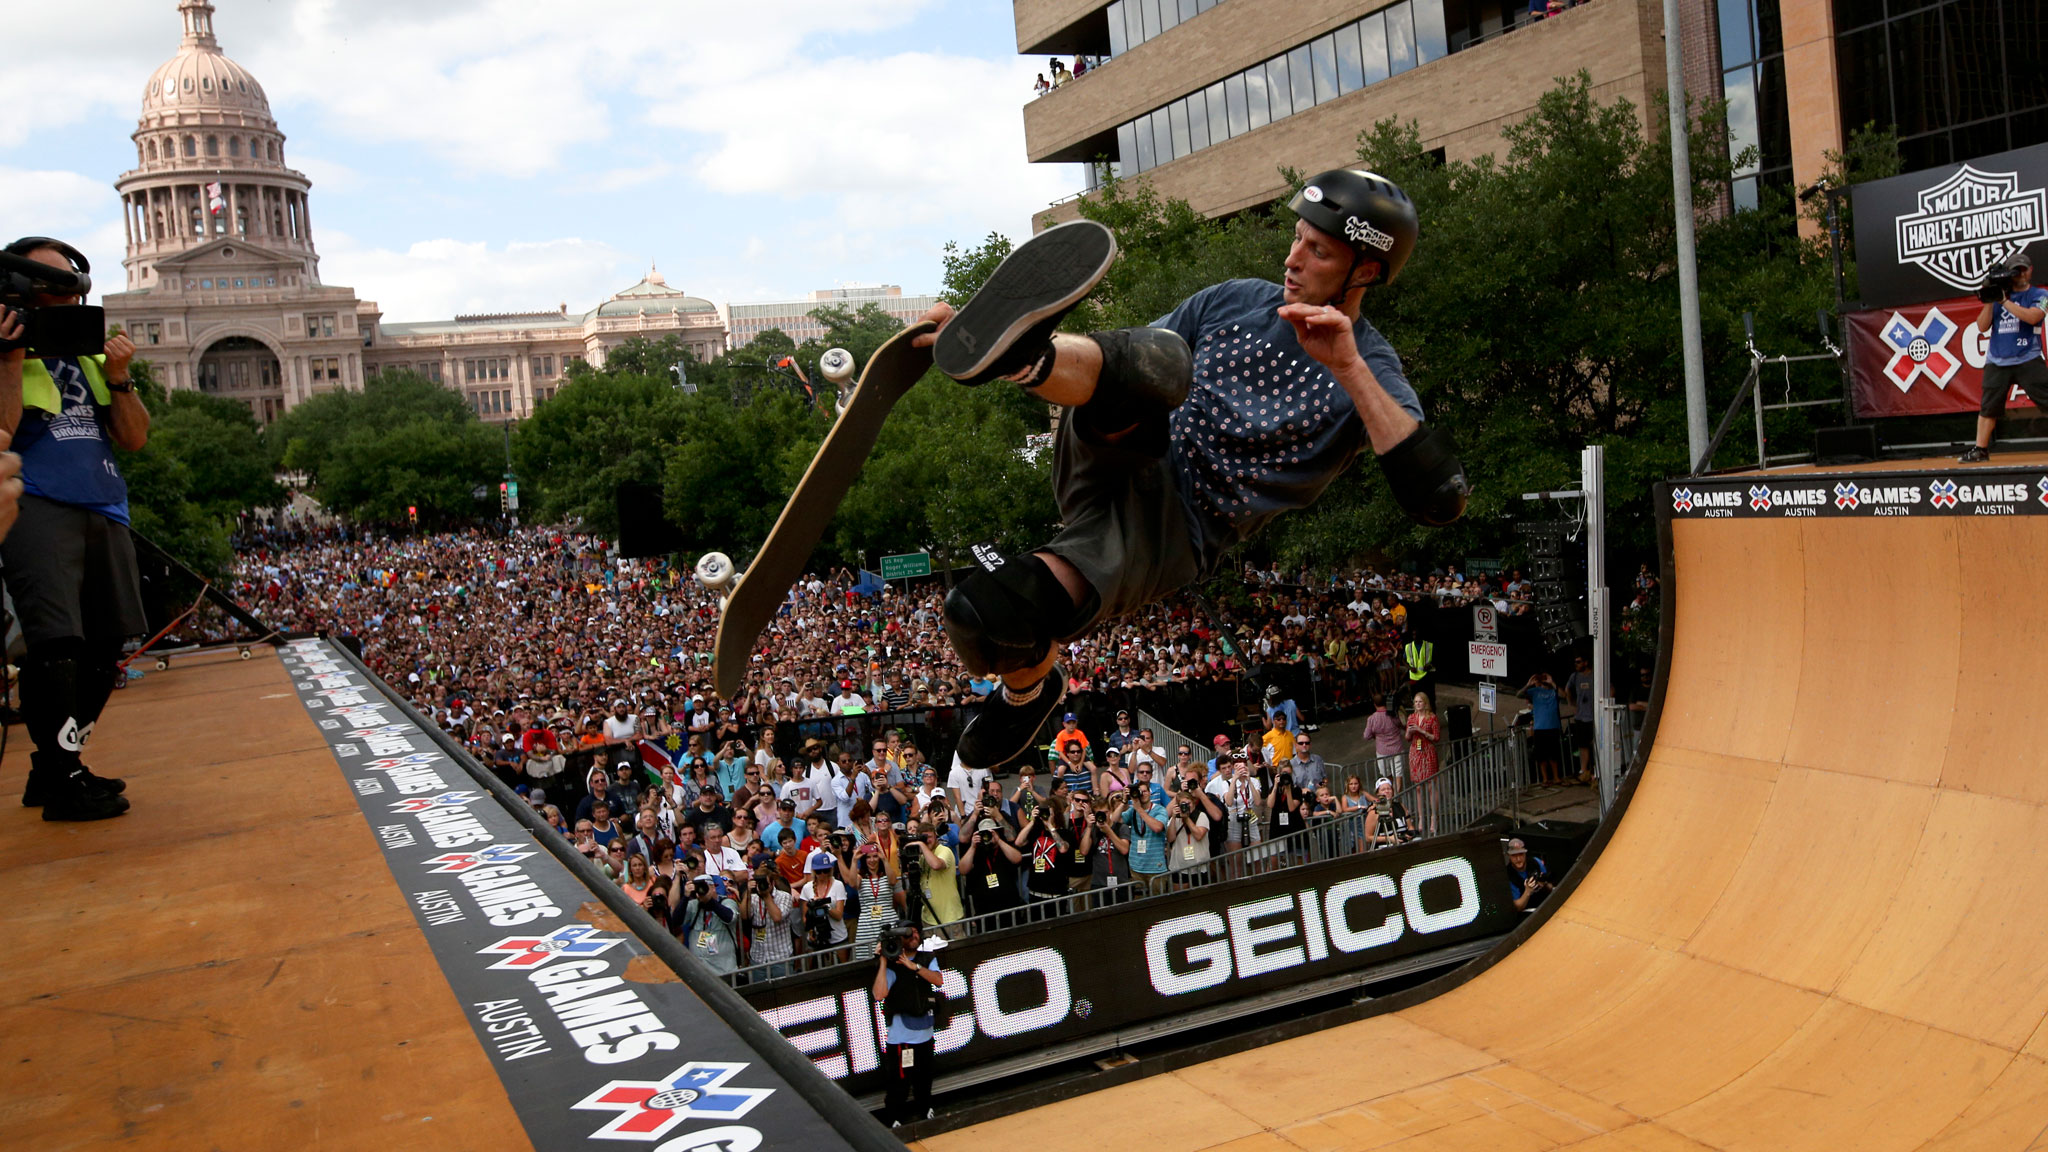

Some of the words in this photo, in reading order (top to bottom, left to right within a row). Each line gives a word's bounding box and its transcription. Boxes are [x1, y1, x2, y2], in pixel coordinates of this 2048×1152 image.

[1935, 180, 2000, 213] MOTOR
[1908, 204, 2032, 250] HARLEY-DAVIDSON
[1937, 242, 2004, 279] CYCLES
[2016, 338, 2028, 346] 28
[52, 427, 100, 438] BROADCAST
[1693, 491, 1742, 507] GAMES
[1772, 488, 1827, 506] GAMES
[1859, 487, 1921, 504] GAMES
[1958, 484, 2029, 503] GAMES
[1705, 509, 1733, 518] AUSTIN
[1784, 507, 1816, 517] AUSTIN
[1873, 506, 1909, 516] AUSTIN
[1974, 505, 2015, 515] AUSTIN
[980, 544, 1005, 565] 187
[1471, 644, 1506, 657] EMERGENCY
[1482, 659, 1495, 670] EXIT
[377, 824, 417, 849] AUSTIN
[414, 806, 494, 848] GAMES
[457, 864, 563, 927] GAMES
[413, 889, 467, 926] AUSTIN
[1144, 856, 1481, 996] GEICO
[528, 959, 681, 1064] GAMES
[757, 946, 1071, 1081] EICO
[474, 998, 552, 1061] AUSTIN
